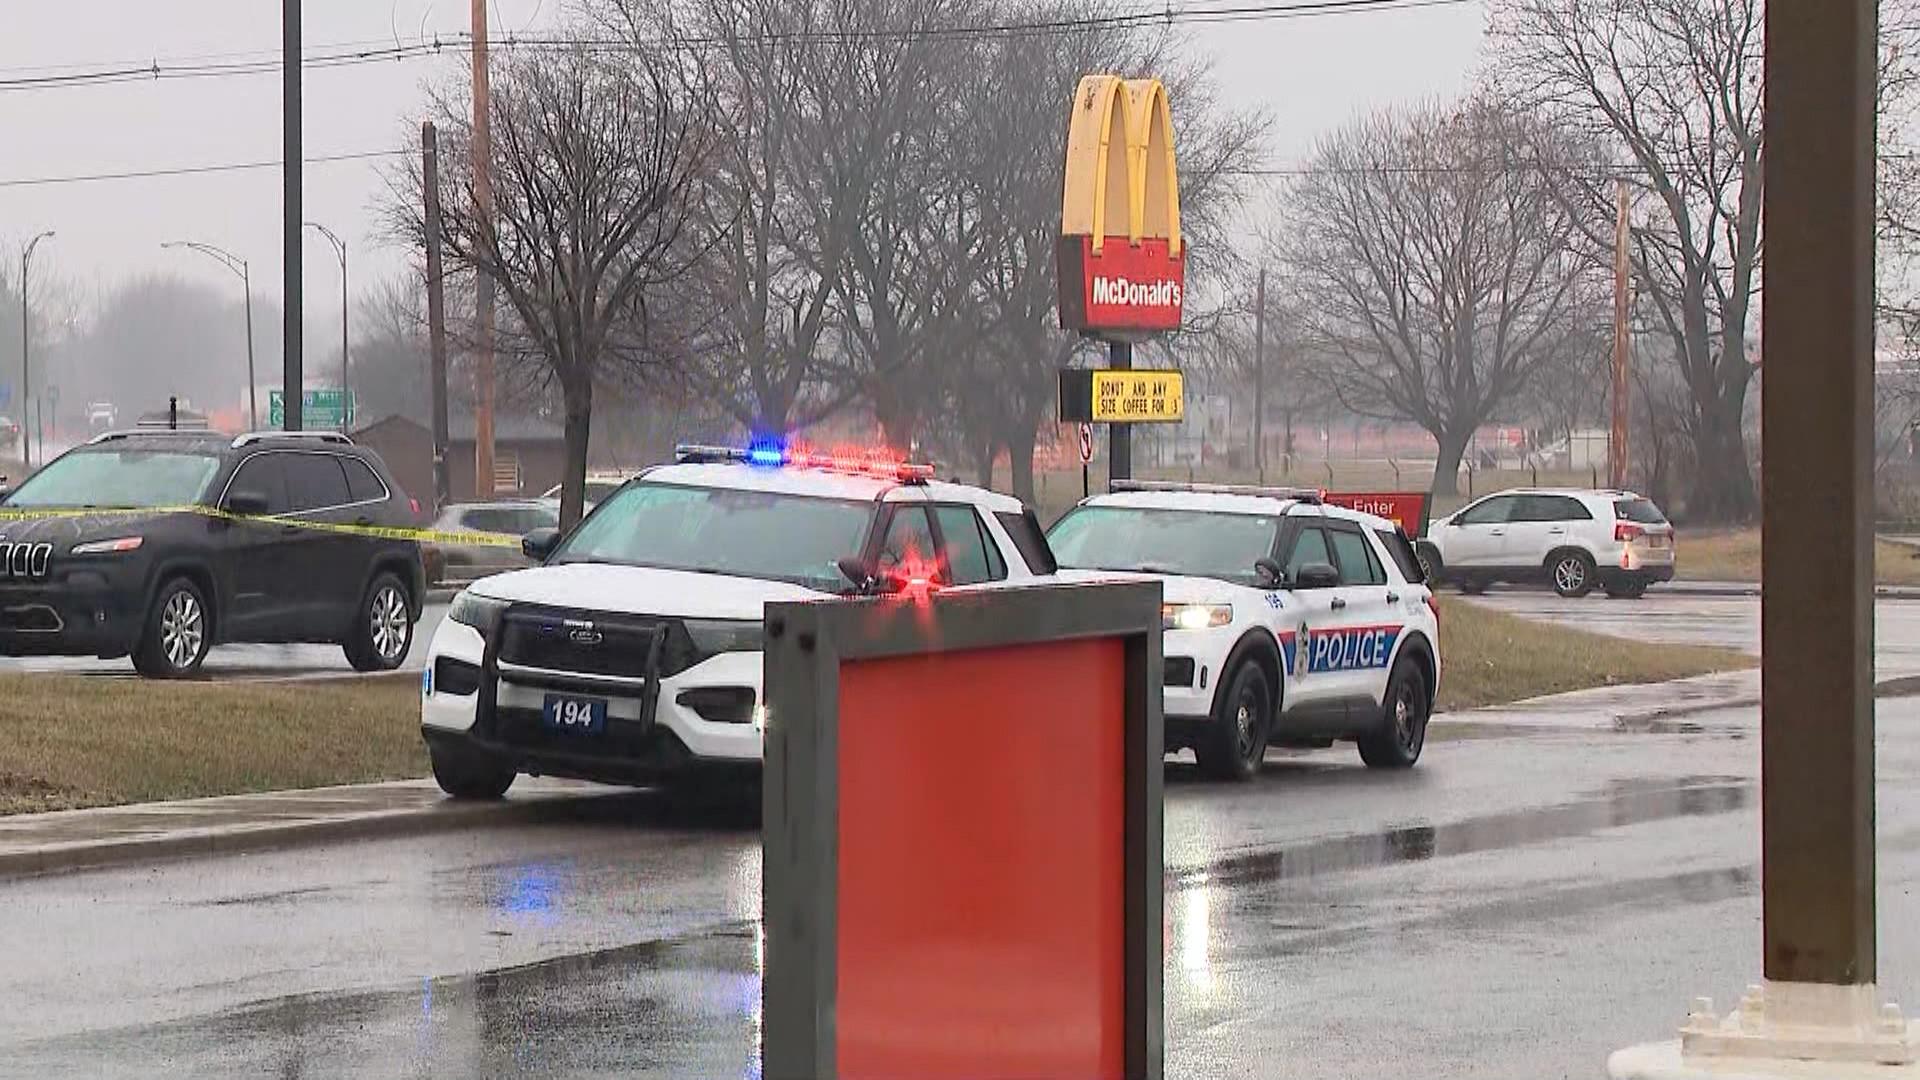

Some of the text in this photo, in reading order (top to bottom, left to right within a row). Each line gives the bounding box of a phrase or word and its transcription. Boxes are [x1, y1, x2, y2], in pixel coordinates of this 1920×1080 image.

[1093, 276, 1182, 306] McDonald's
[1101, 381, 1167, 396] DONUT AND ANY
[1101, 399, 1116, 414] SIZE
[1123, 399, 1147, 414] COFFEE
[1152, 399, 1165, 414] FOR
[1353, 499, 1396, 515] Enter
[1313, 631, 1386, 669] POLICE
[552, 700, 592, 727] 194
